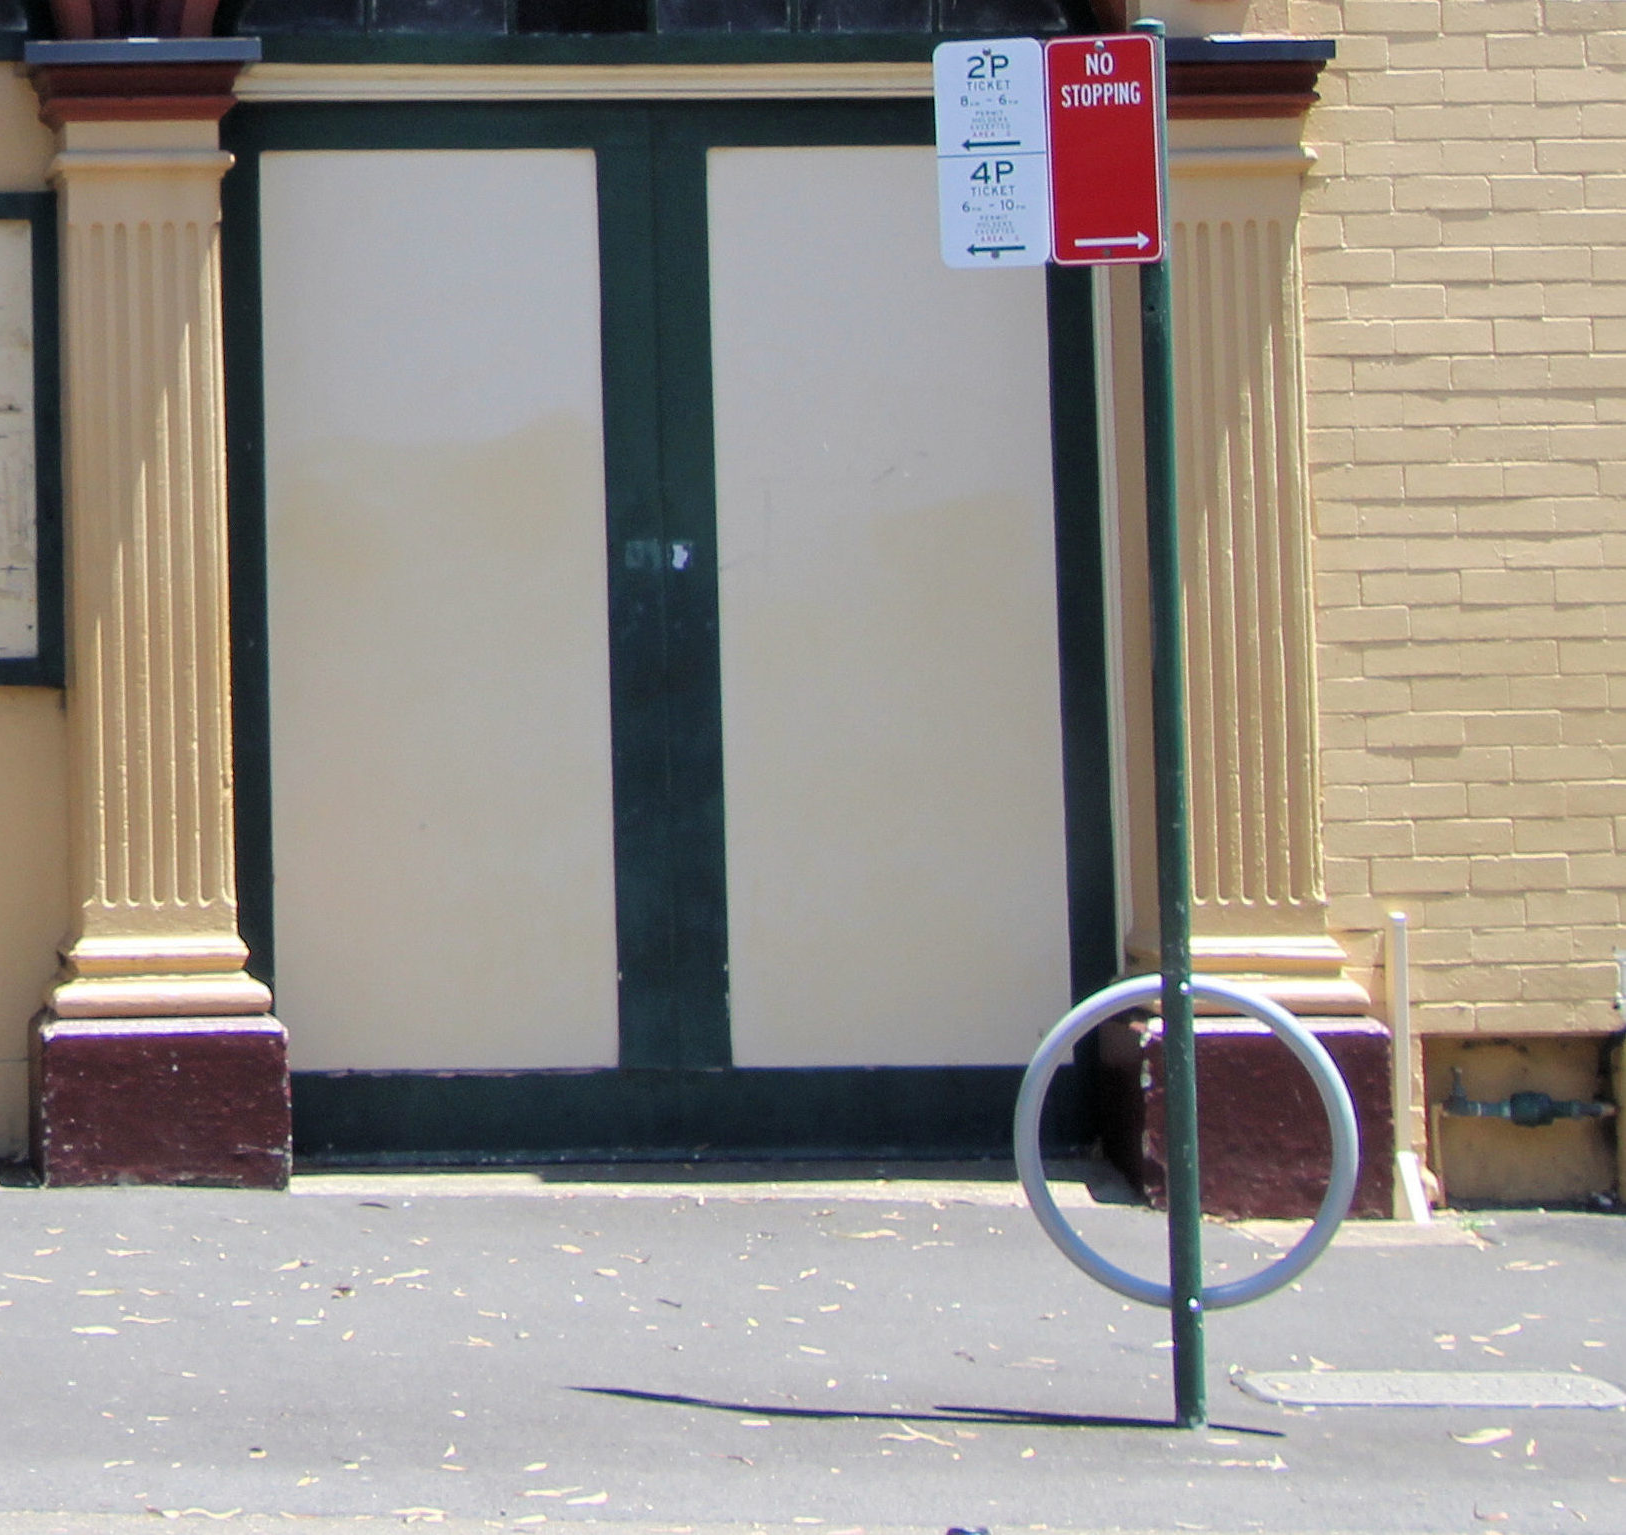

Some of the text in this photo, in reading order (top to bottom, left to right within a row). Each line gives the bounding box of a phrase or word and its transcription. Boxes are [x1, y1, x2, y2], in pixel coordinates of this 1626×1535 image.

[967, 55, 1009, 79] 2P
[1085, 52, 1114, 76] NO
[967, 80, 1011, 91] TICKET
[1061, 81, 1141, 108] STOPPING
[971, 161, 1014, 184] 4P
[971, 186, 1015, 196] TICKET
